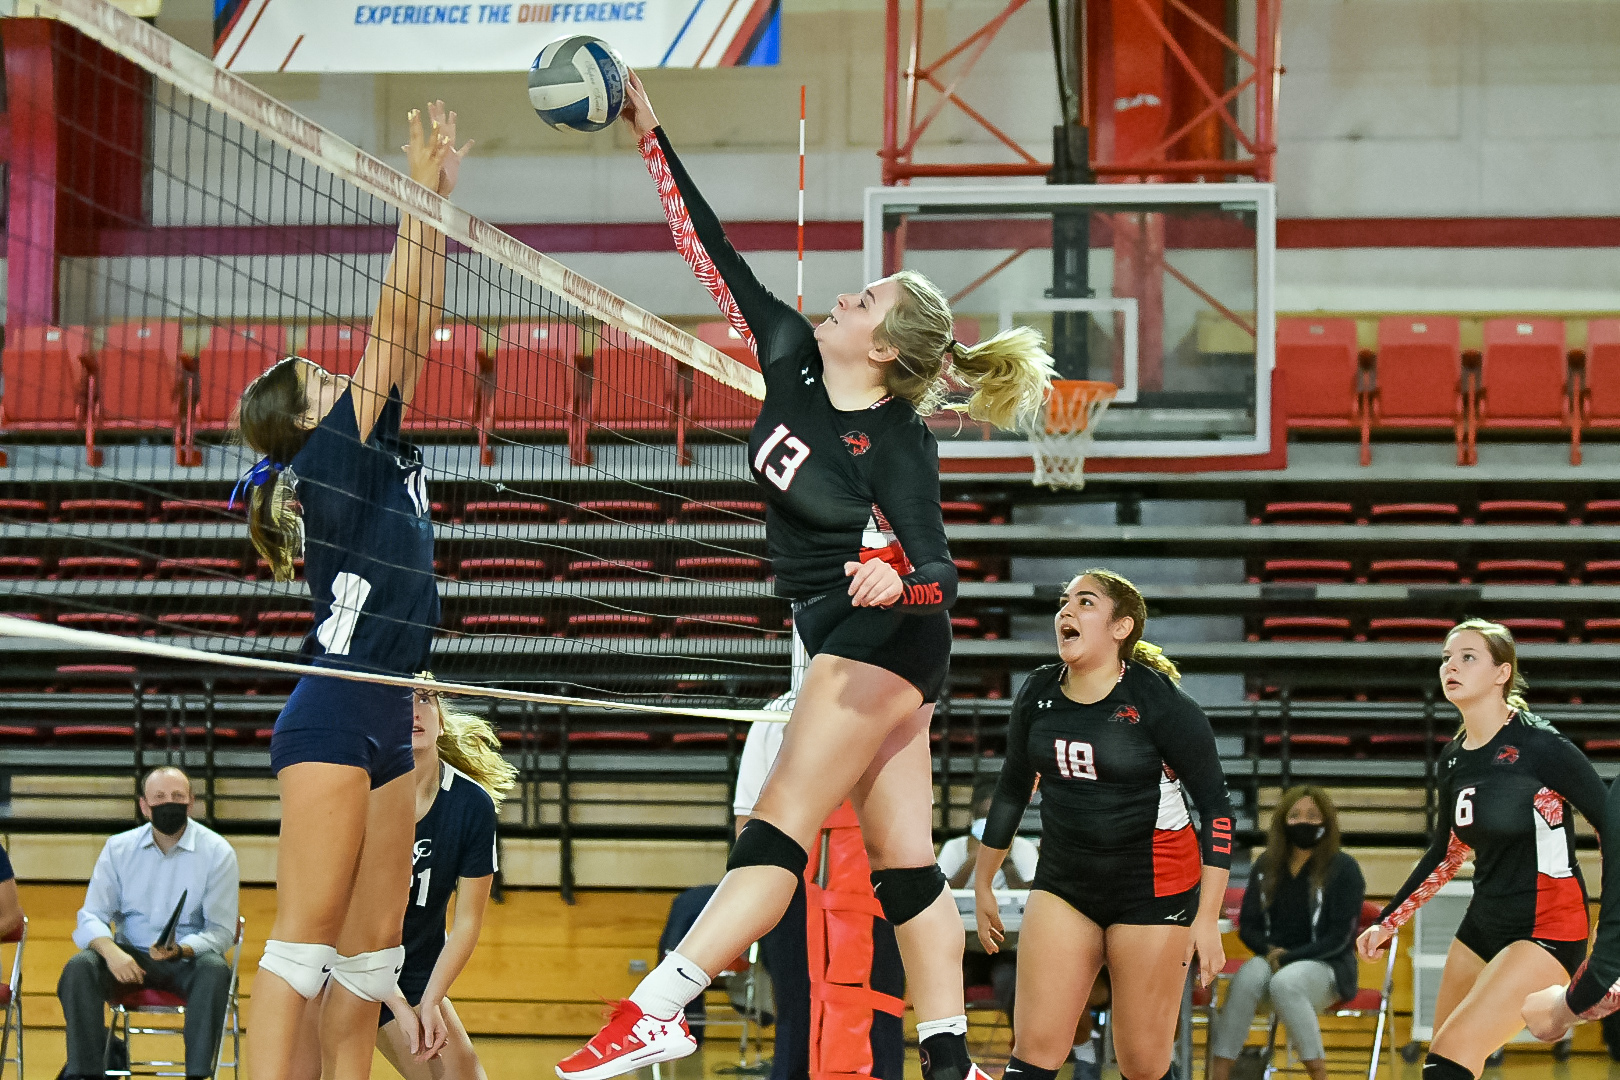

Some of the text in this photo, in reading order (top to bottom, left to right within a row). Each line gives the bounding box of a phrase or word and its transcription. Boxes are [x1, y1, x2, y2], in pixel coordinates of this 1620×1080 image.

[354, 5, 472, 25] EXPERIENCE
[478, 4, 512, 23] THE
[754, 423, 811, 492] 13
[1053, 738, 1098, 781] 18
[1455, 786, 1476, 827] 6
